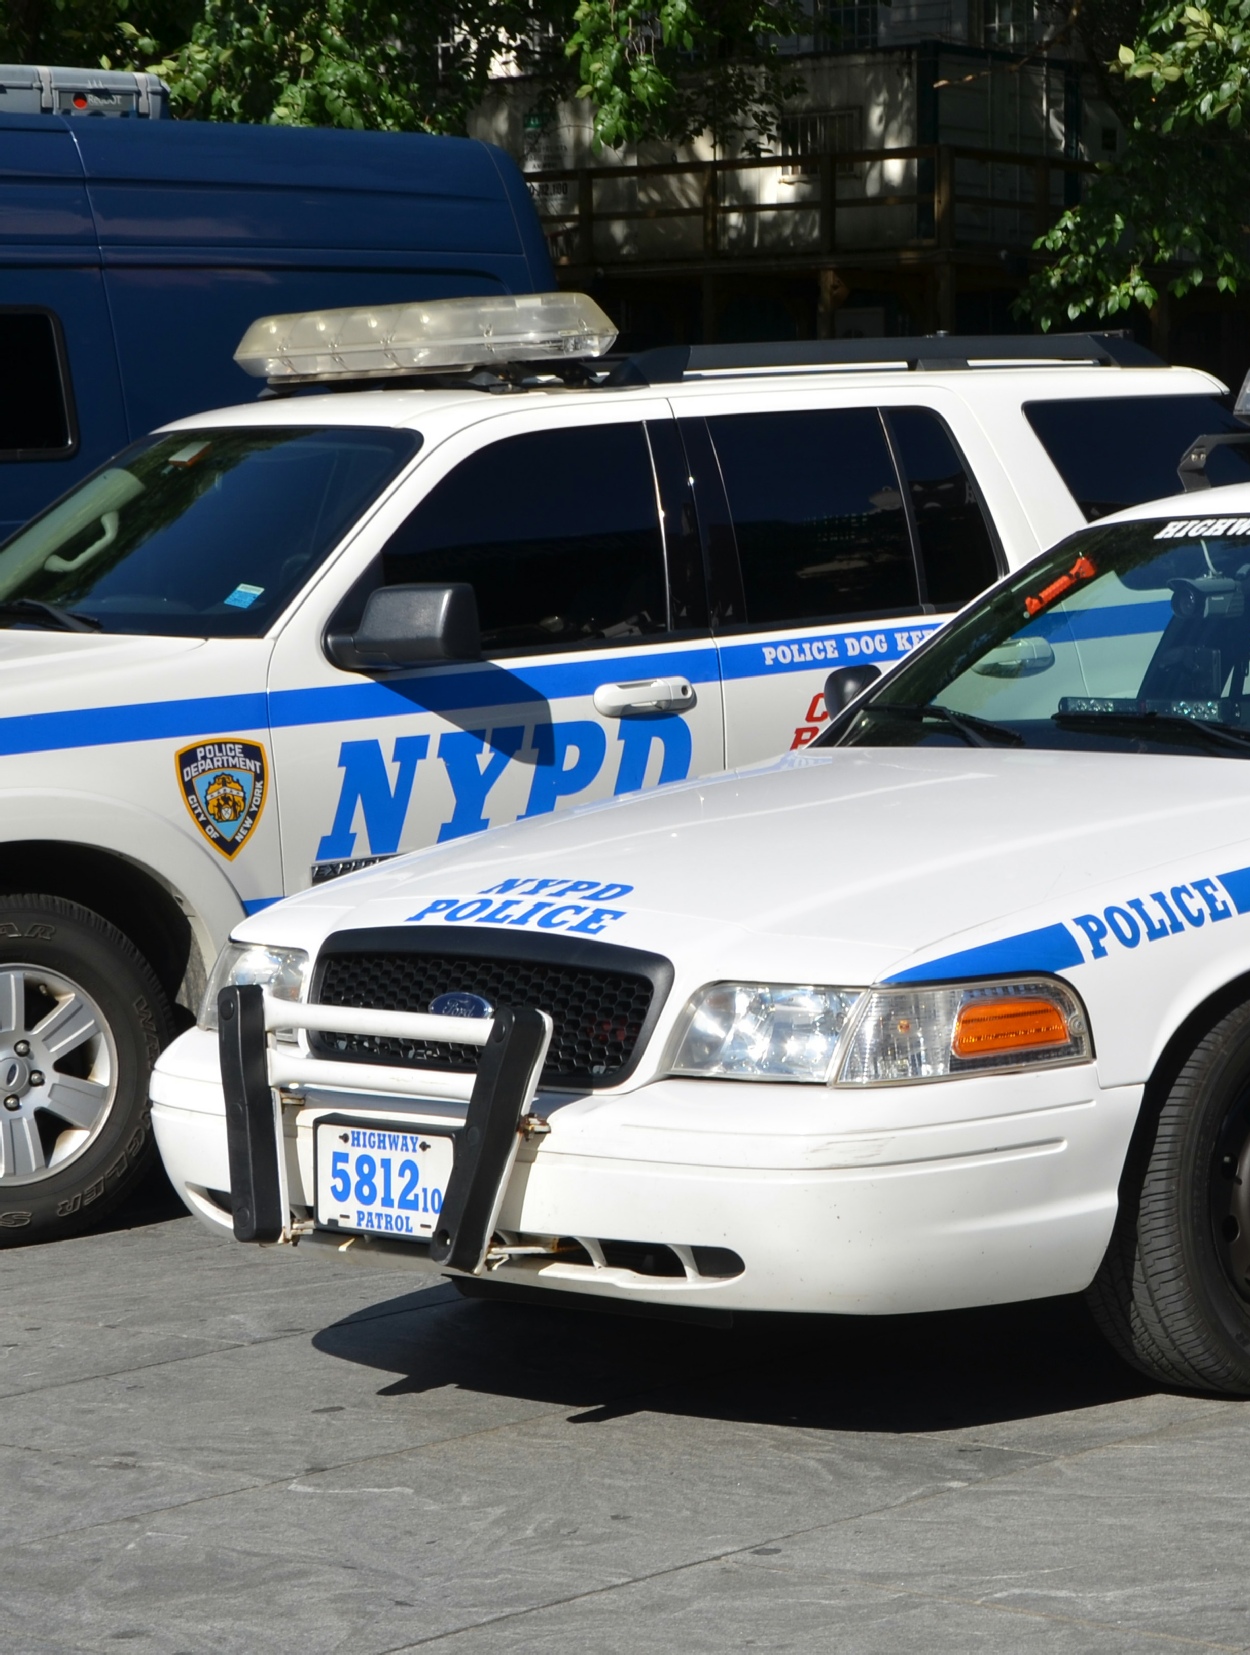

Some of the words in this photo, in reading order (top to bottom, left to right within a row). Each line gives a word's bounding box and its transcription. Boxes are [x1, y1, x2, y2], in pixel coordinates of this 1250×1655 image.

[761, 638, 839, 666] POLICE
[844, 634, 888, 657] DOG
[196, 743, 244, 761] POLICE
[183, 756, 262, 782] DEPARTMENT
[315, 713, 693, 861] NYPD
[188, 795, 207, 822] CITY
[205, 824, 220, 839] OF
[235, 816, 254, 842] NEW
[249, 780, 264, 812] YORK
[476, 878, 635, 901] NYPD
[403, 898, 629, 935] POLICE
[1071, 877, 1233, 960] POLICE
[350, 1129, 419, 1153] HIGHWAY
[330, 1151, 420, 1212] 5812
[421, 1187, 444, 1214] 10
[356, 1210, 414, 1233] PATROL
